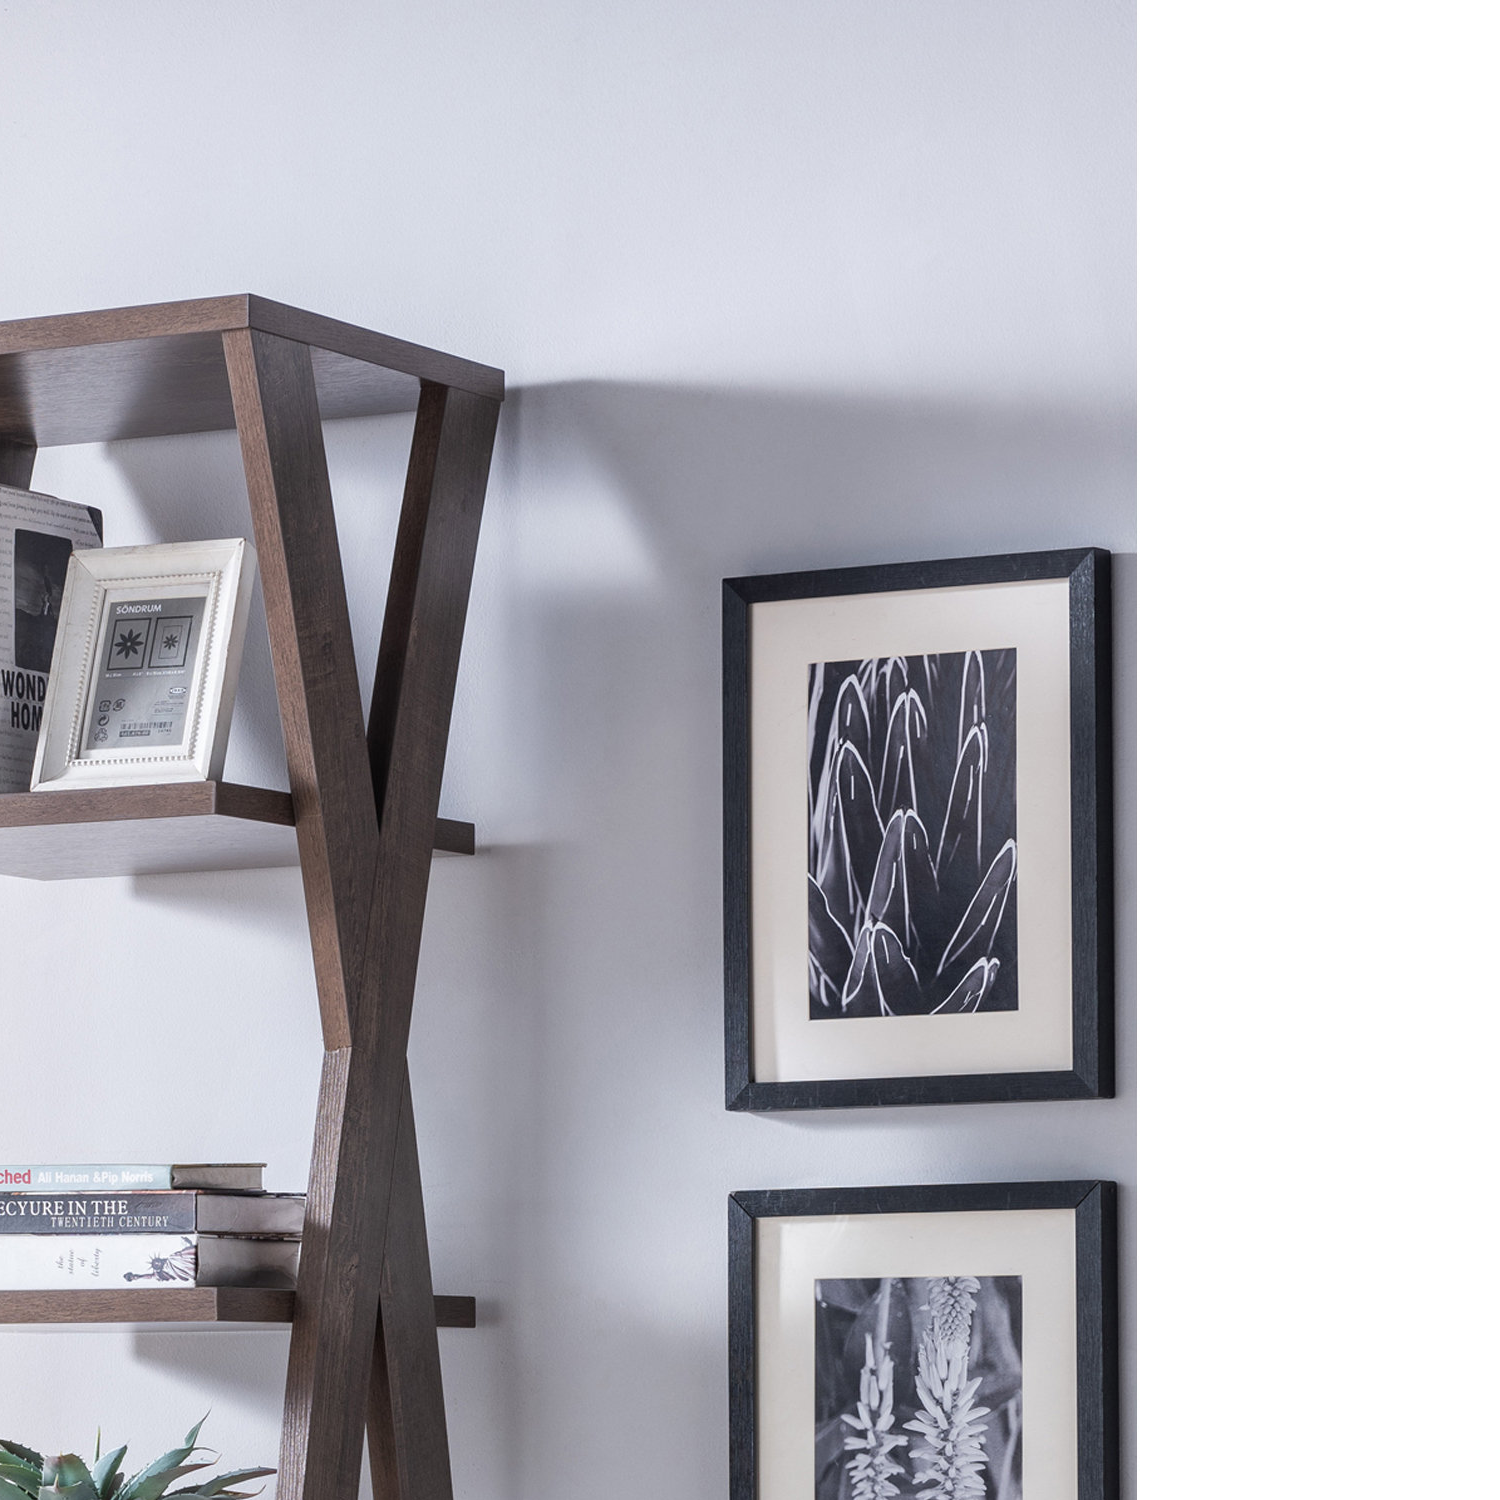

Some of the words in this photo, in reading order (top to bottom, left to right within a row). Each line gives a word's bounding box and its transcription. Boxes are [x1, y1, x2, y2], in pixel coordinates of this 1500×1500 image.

[116, 604, 162, 615] SÖNDRUM
[1, 669, 49, 702] WOND
[55, 1171, 89, 1183] Hanan
[121, 1170, 154, 1183] Norris
[67, 1200, 88, 1216] IN
[90, 1200, 128, 1216] THE
[51, 1216, 115, 1228] TWENTIETH
[119, 1215, 169, 1228] CENTURY
